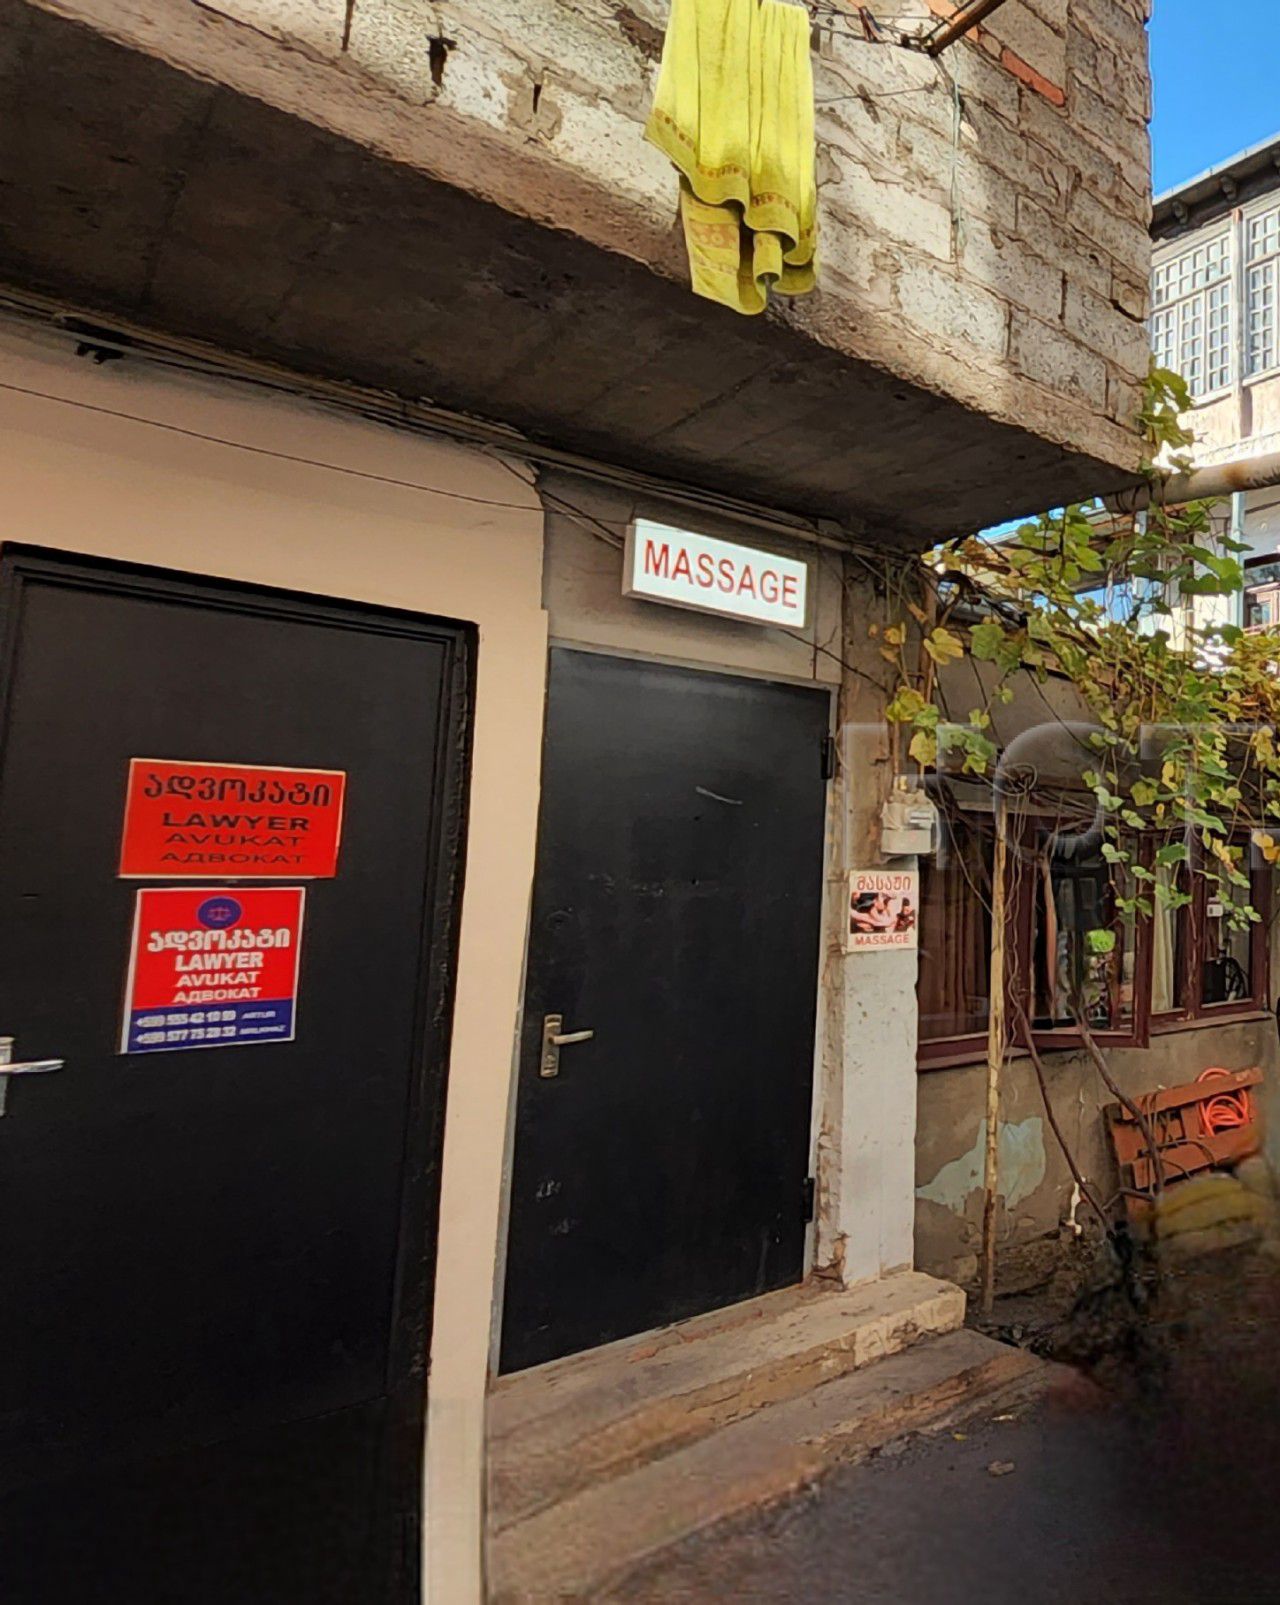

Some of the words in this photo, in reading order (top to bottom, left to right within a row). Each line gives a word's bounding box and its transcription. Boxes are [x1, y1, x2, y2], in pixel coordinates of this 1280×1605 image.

[644, 539, 798, 609] MASSAGE
[144, 773, 331, 807] ადვოკატი
[162, 812, 310, 831] LAWYER
[164, 833, 305, 848] AVUKAT
[160, 852, 306, 865] АДВОКАТ
[857, 874, 912, 891] მასაჟი
[147, 928, 291, 953] ადვოკატი
[855, 934, 910, 946] MASSAGE
[175, 952, 264, 972] LAWYER
[176, 971, 262, 988] AVUKAT
[172, 987, 262, 1005] АДВОКАТ
